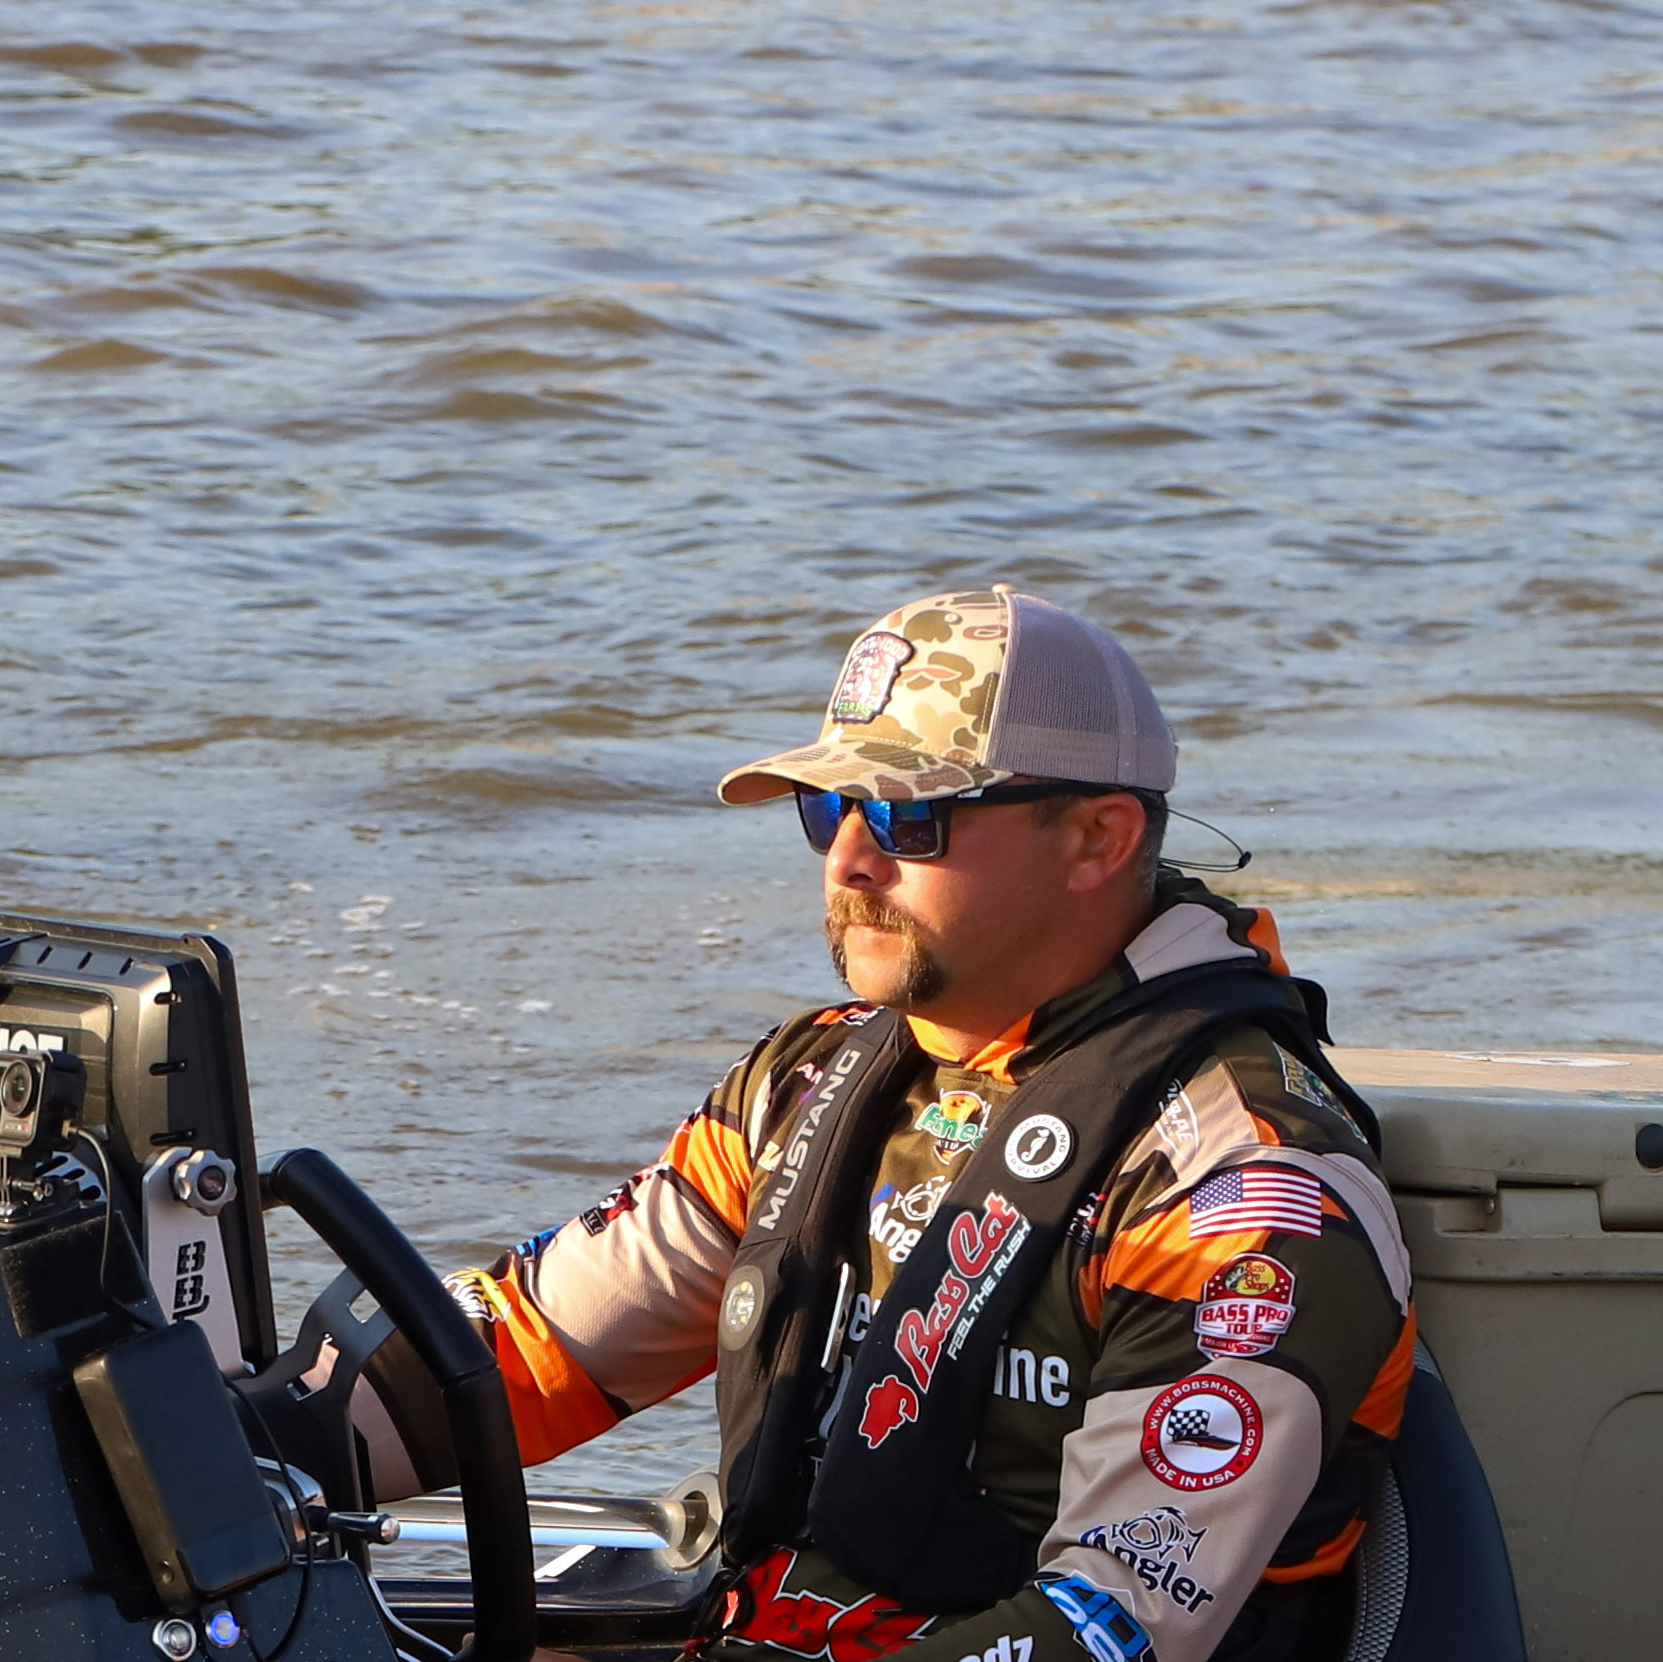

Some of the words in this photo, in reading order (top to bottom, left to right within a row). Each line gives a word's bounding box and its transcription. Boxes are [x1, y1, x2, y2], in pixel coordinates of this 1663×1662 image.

[757, 1048, 863, 1231] MUSTANG
[946, 1316, 976, 1361] FEEL
[967, 1275, 998, 1315] THE
[991, 1218, 1033, 1277] RUSH
[1201, 1303, 1249, 1323] BASS
[1254, 1303, 1289, 1322] PRO
[1150, 1379, 1257, 1458] WWW.BOBSMACHINE.COM
[1145, 1448, 1177, 1481] MADE
[1179, 1476, 1198, 1488] IN
[1202, 1470, 1235, 1488] USA
